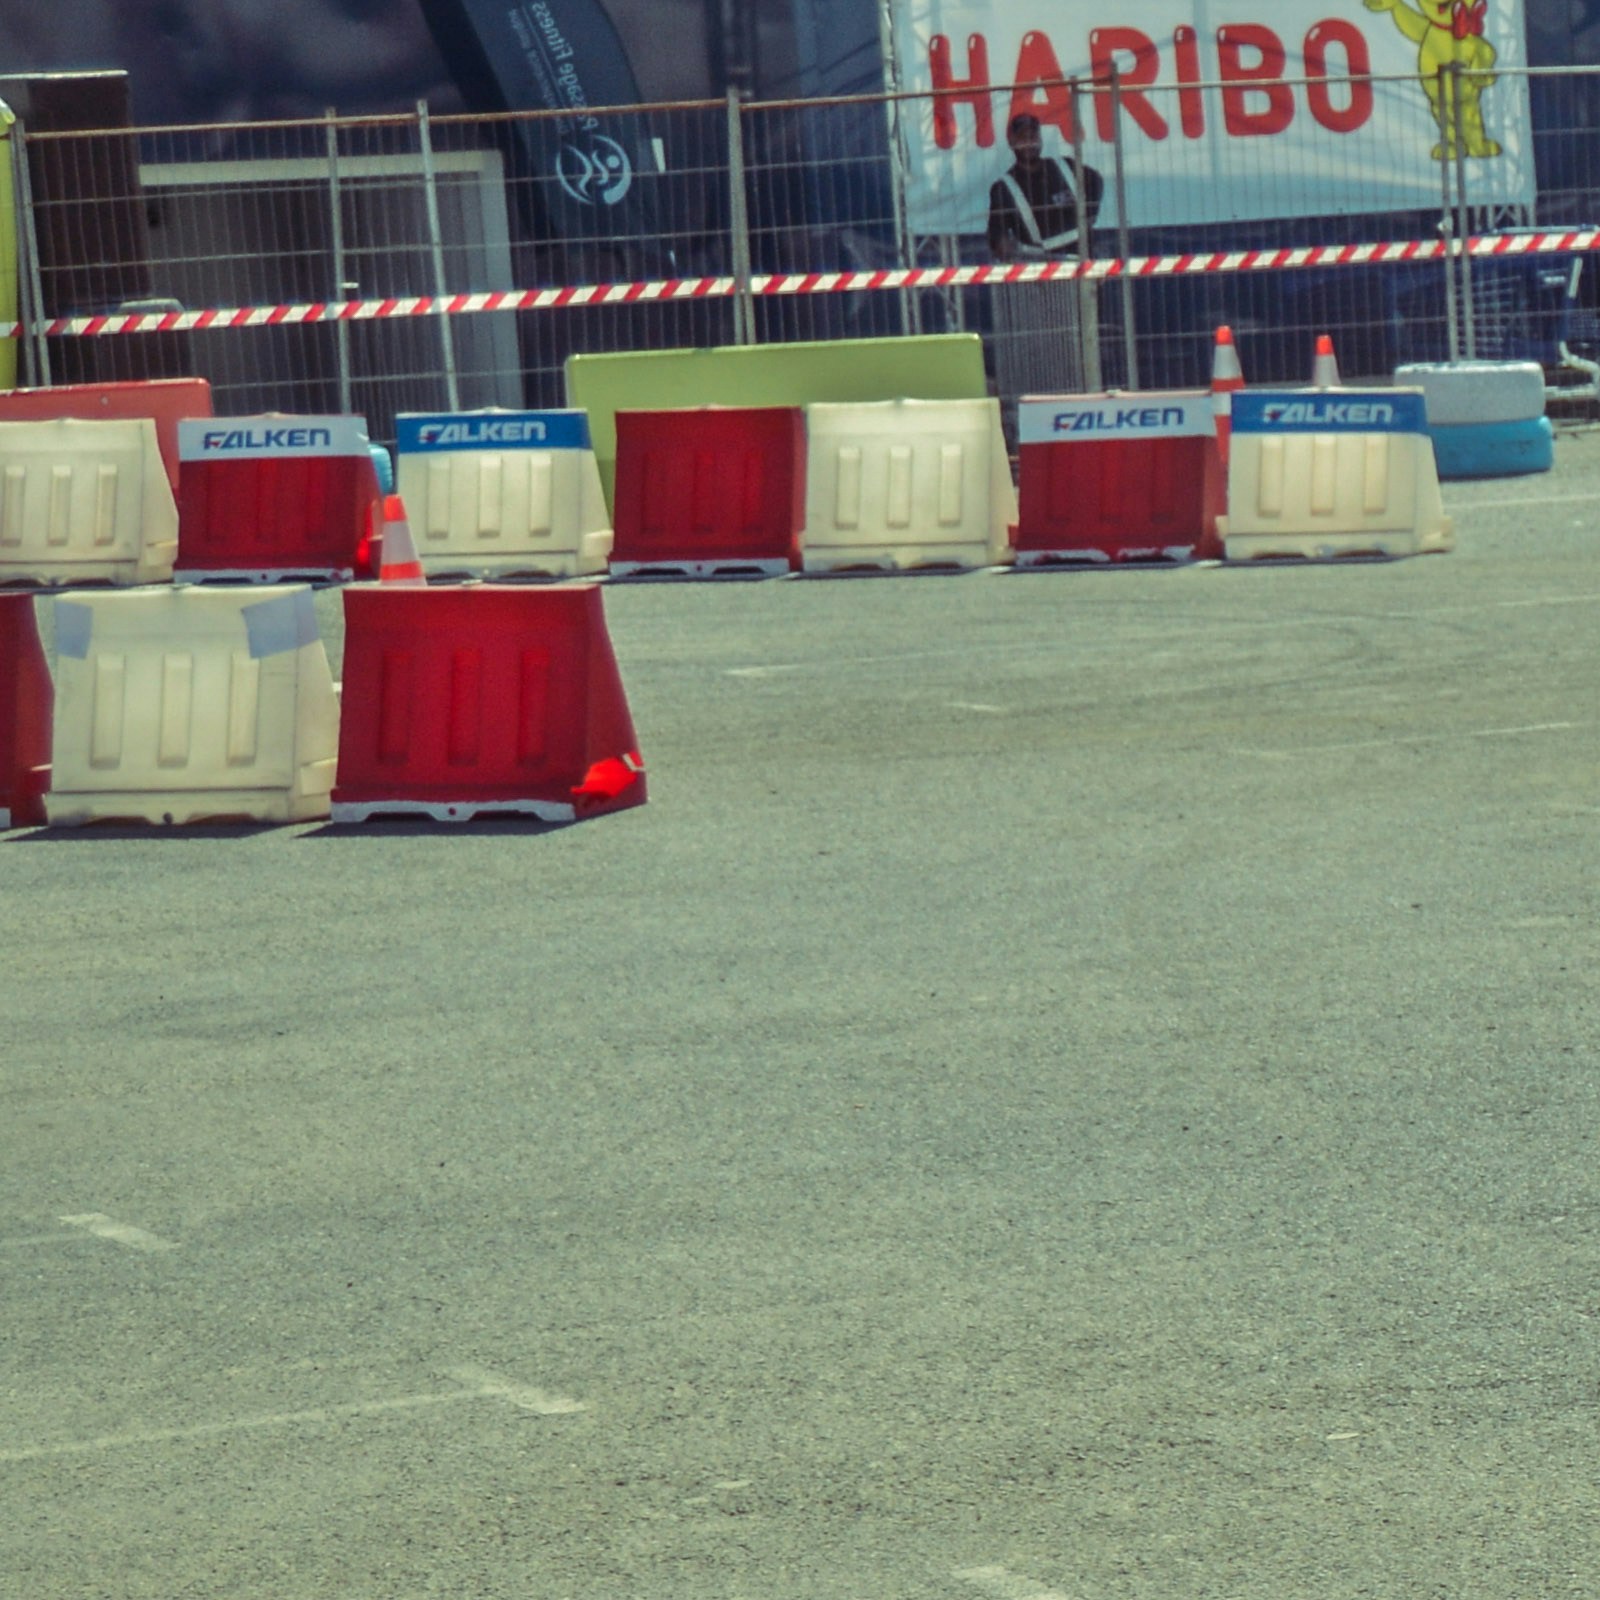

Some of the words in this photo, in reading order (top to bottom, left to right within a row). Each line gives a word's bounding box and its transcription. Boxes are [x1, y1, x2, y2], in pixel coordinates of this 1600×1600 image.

[929, 17, 1375, 150] HARIBO
[1053, 407, 1185, 431] FALKEN
[1263, 402, 1393, 424] FALKEN
[202, 428, 331, 451] FALKEN
[418, 421, 547, 445] FALKEN
